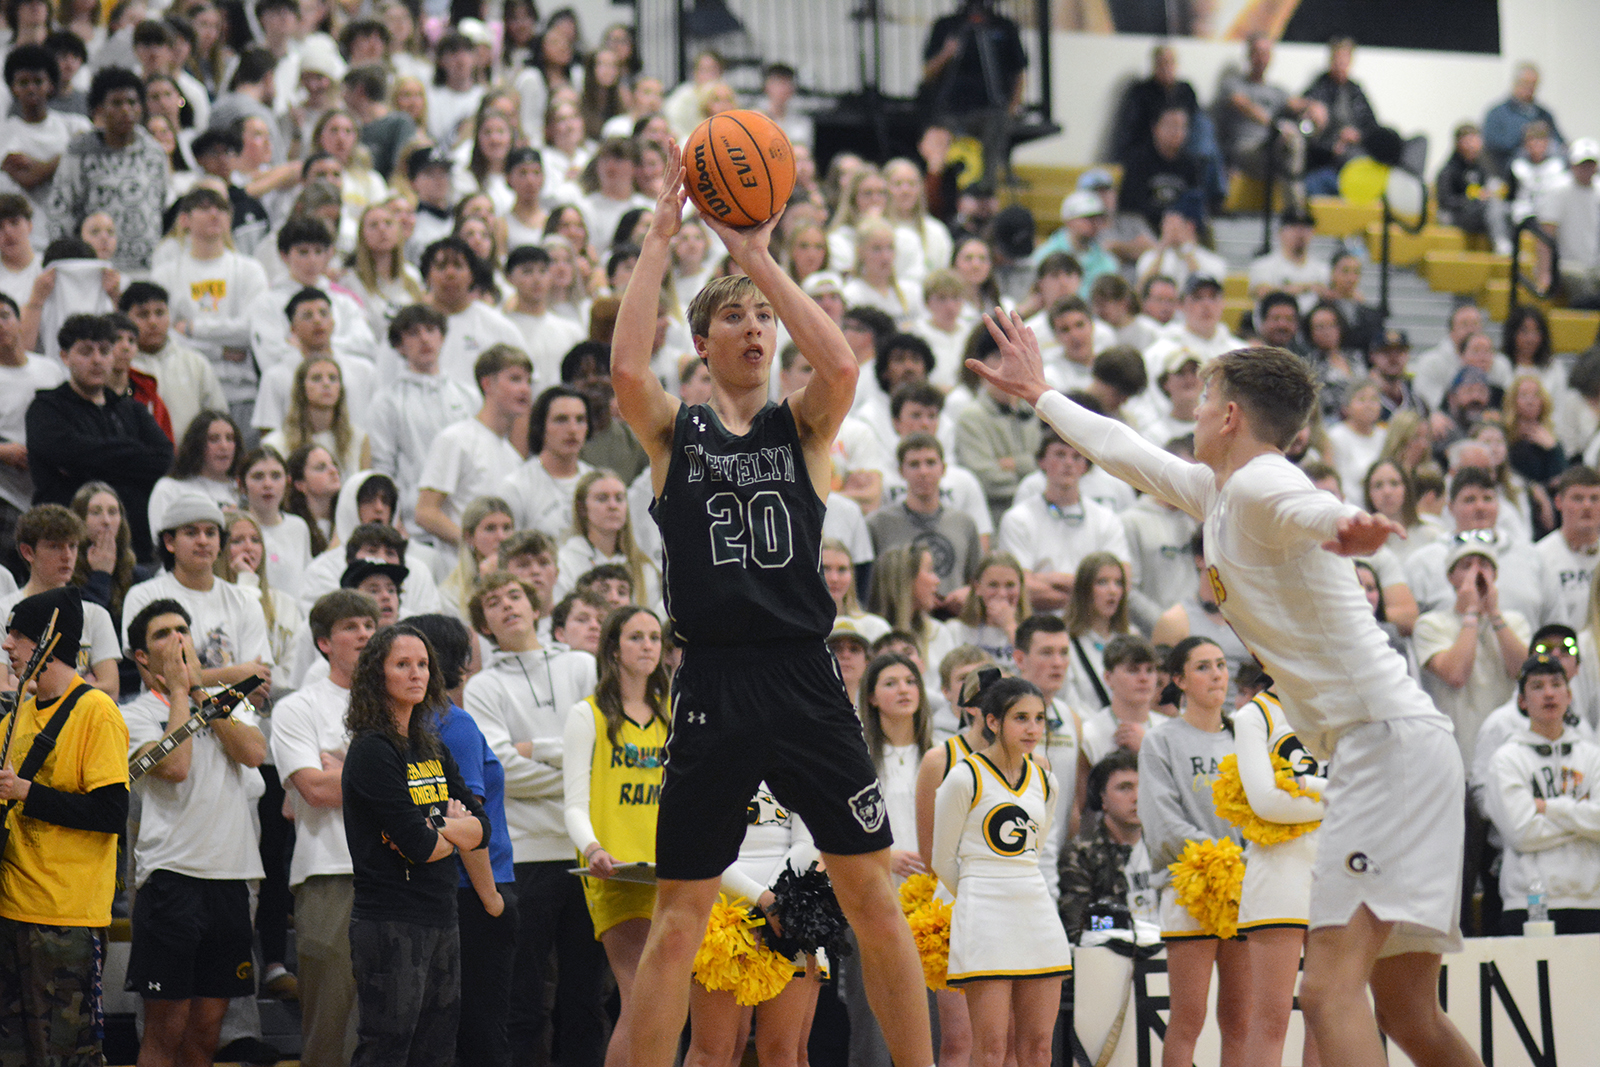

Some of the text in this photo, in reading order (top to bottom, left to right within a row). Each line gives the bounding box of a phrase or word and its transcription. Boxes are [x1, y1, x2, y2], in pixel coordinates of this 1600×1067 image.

[694, 143, 732, 218] Wilson
[684, 443, 796, 487] D'EVELYN
[706, 490, 794, 569] 20
